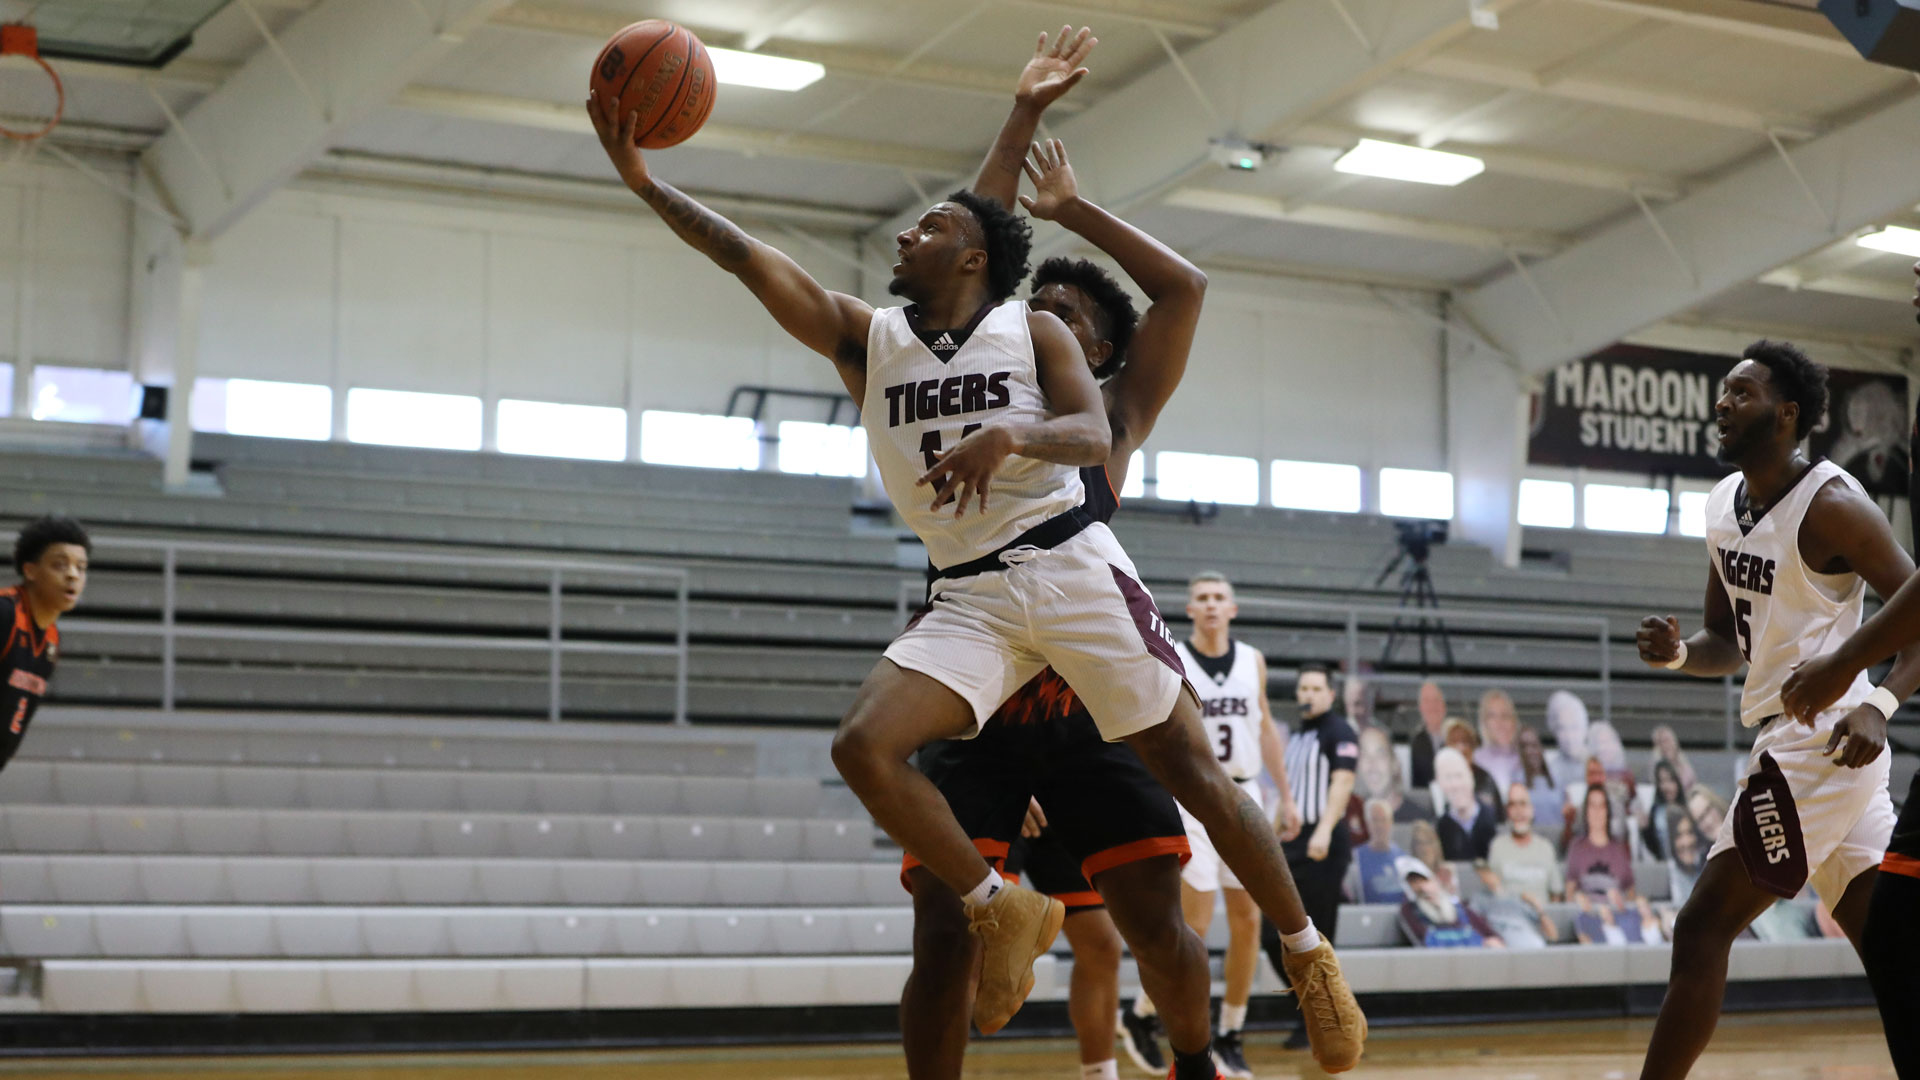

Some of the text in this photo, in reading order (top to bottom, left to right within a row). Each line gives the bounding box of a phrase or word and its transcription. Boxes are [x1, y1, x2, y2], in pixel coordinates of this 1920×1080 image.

[931, 343, 959, 351] adidas
[885, 371, 1011, 428] TIGERS
[1556, 361, 1710, 421] MAROON
[1579, 413, 1701, 457] STUDENT
[1150, 610, 1176, 651] TIG
[1735, 597, 1752, 665] 5
[1201, 697, 1248, 718] IGERS
[1218, 724, 1233, 762] 3
[1751, 789, 1791, 865] TIGERS
